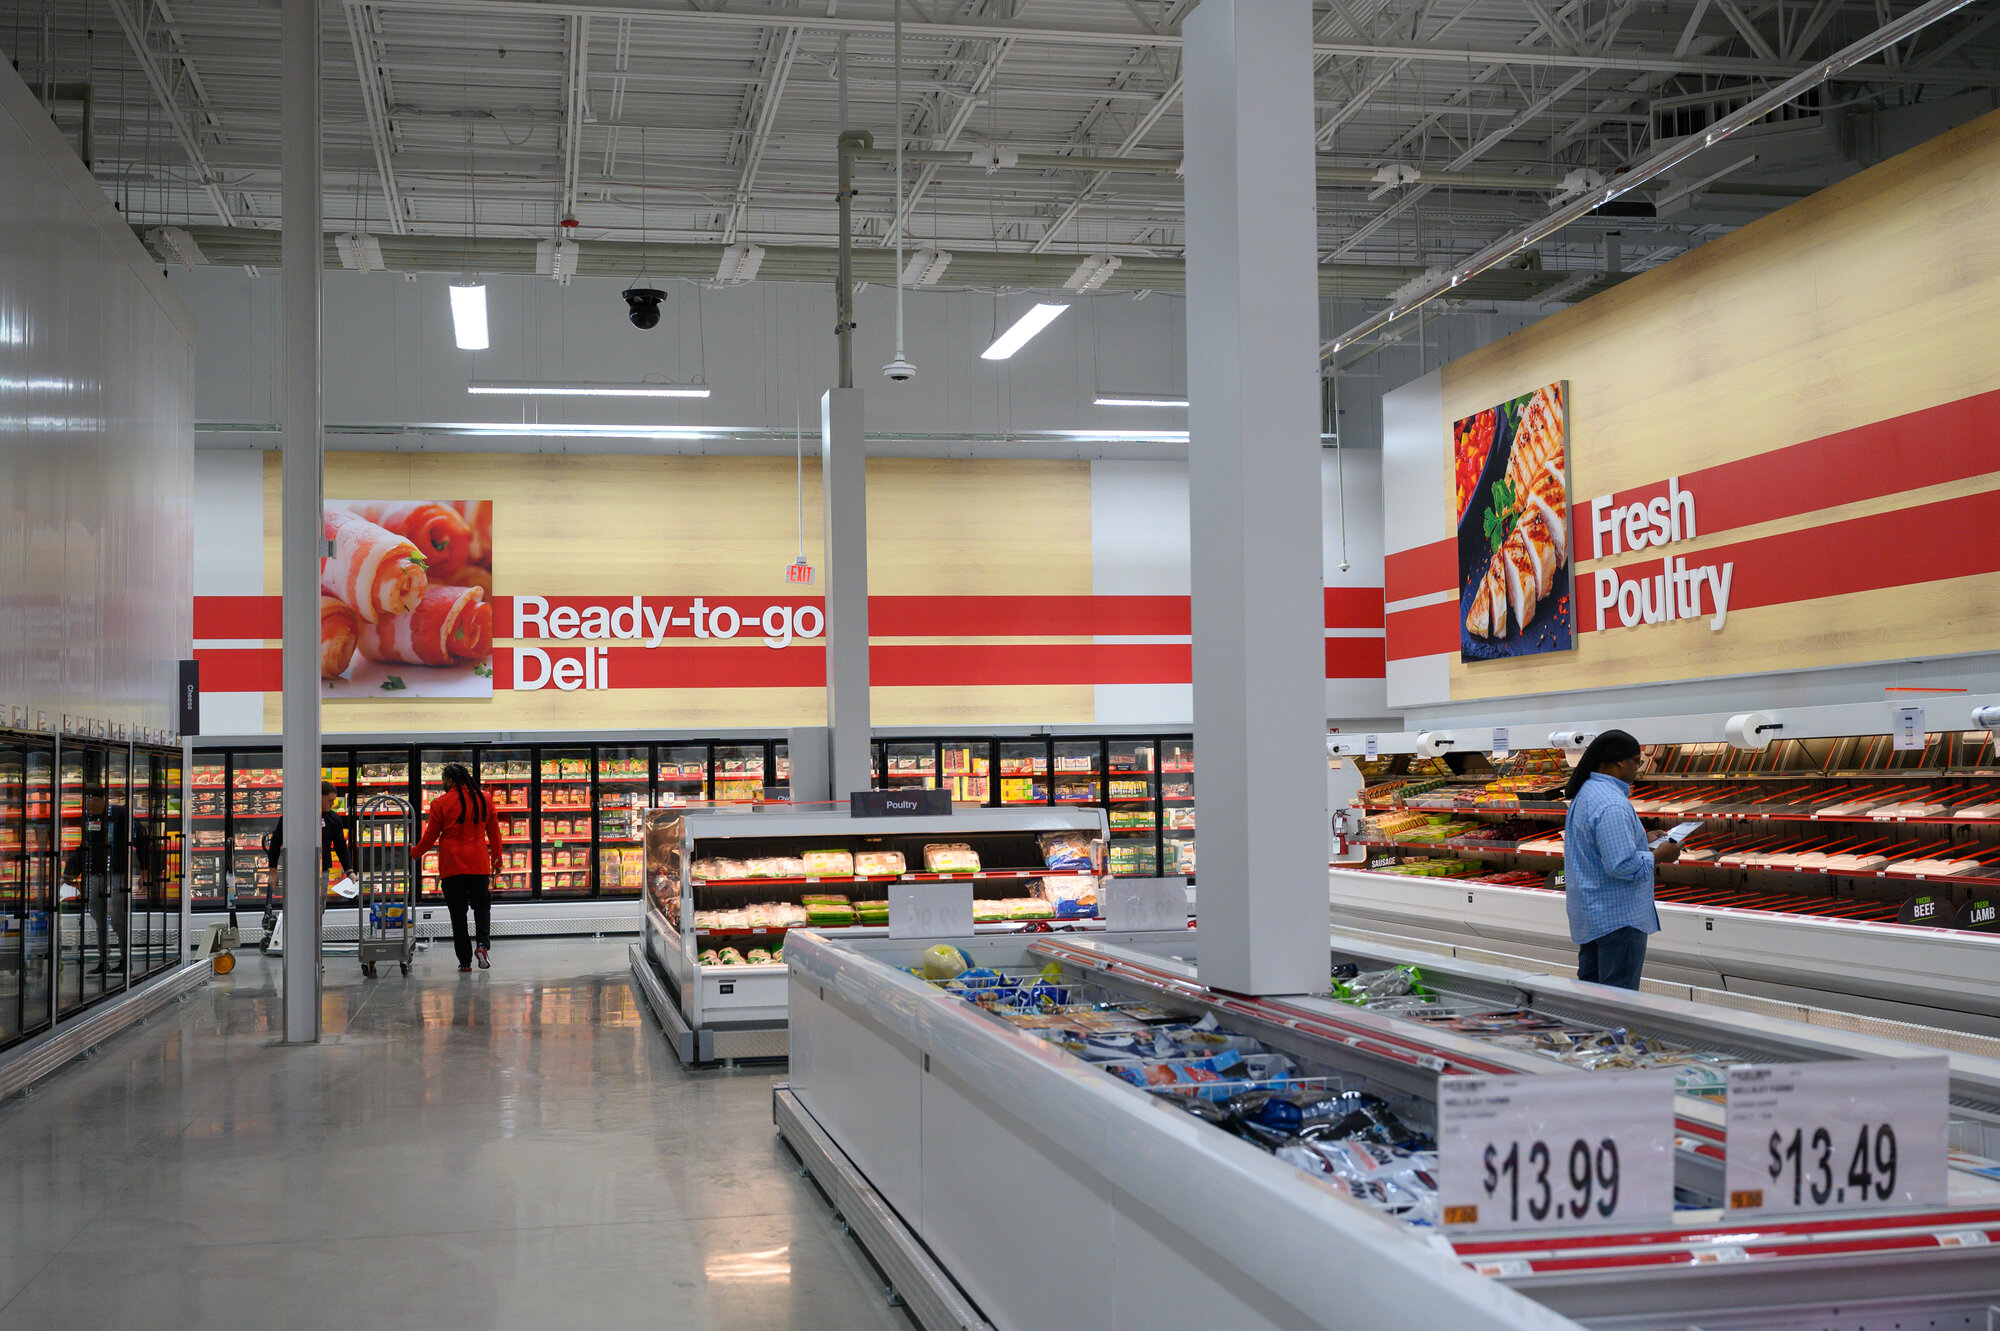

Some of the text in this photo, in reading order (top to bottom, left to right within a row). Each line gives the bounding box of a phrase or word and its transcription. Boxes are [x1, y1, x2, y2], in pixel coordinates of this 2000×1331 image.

[1591, 475, 1697, 560] Fresh
[790, 565, 812, 583] EXIT
[1594, 555, 1734, 631] Poultry
[513, 595, 825, 648] Ready-to-go
[513, 644, 610, 692] Deli
[186, 684, 194, 711] Cheese
[886, 800, 918, 810] Poultry
[1371, 856, 1396, 868] SAUSAGE
[1554, 875, 1566, 886] ME
[1916, 896, 1931, 905] FRESH
[1973, 900, 1989, 910] FRESH
[1913, 902, 1935, 918] BEEF
[1970, 906, 1996, 923] LAMB
[1768, 1122, 1898, 1207] $13.49
[1483, 1137, 1620, 1222] $13.99
